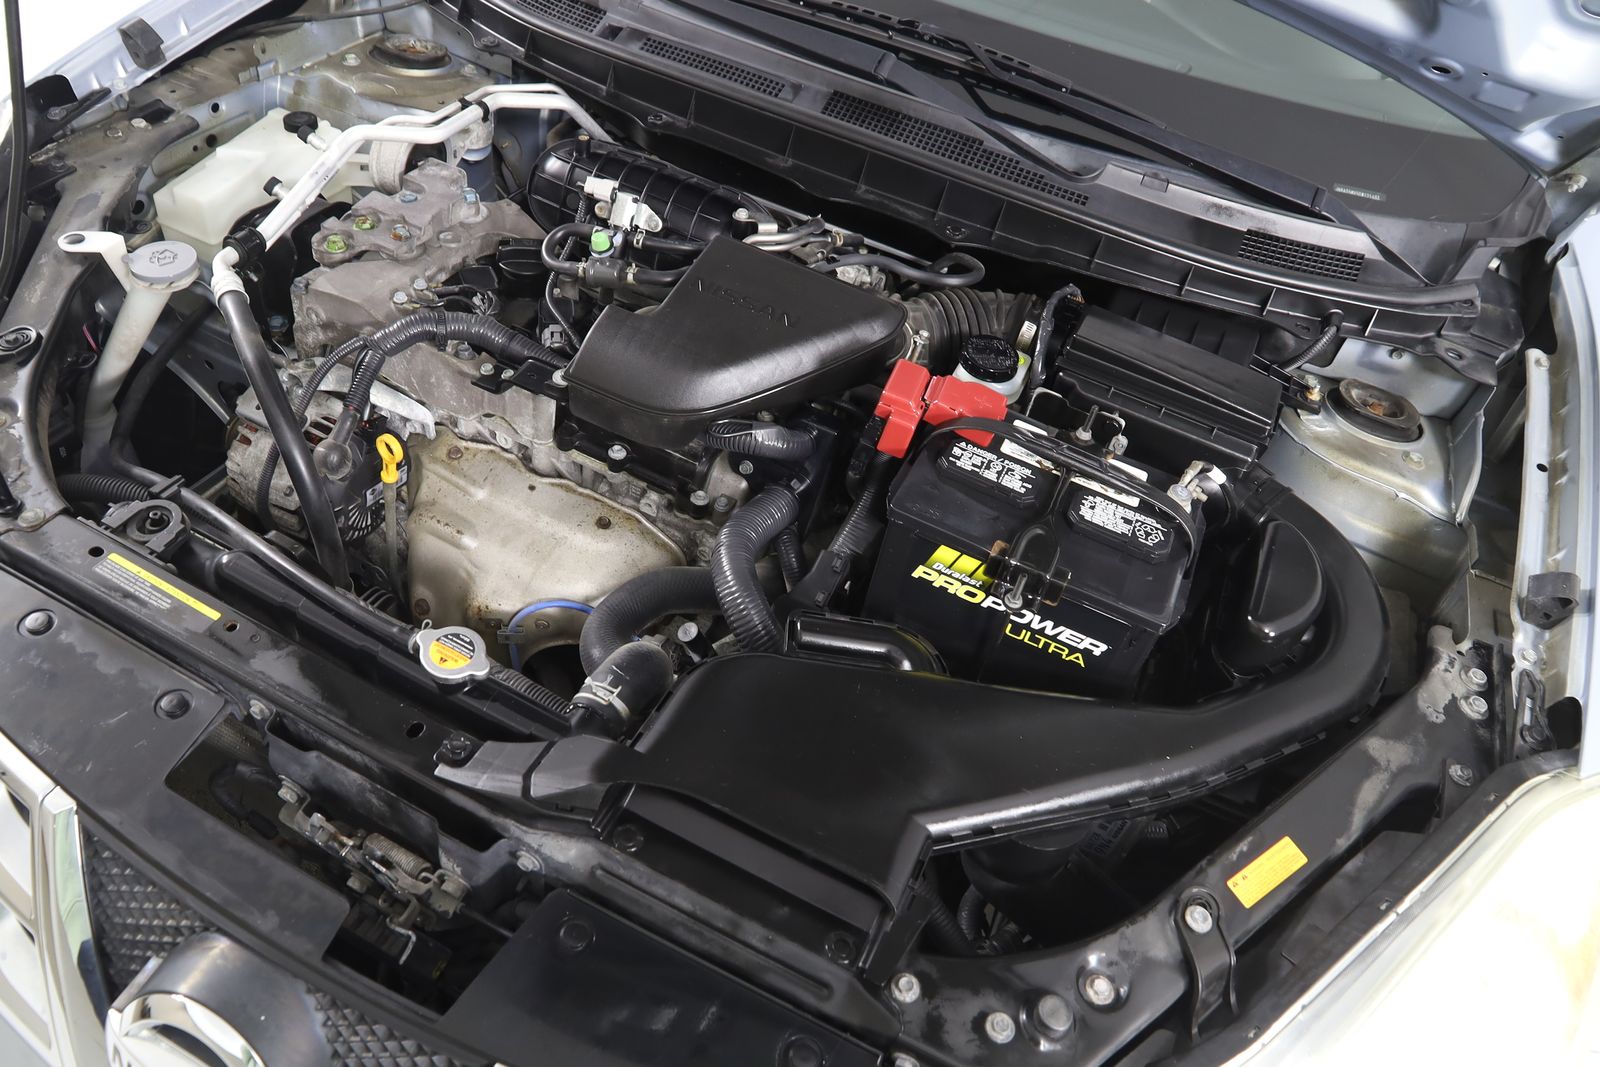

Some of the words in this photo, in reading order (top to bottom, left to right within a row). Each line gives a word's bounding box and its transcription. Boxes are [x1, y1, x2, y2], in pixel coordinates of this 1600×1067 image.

[967, 444, 998, 461] DANGER
[1004, 459, 1032, 475] POISON
[931, 561, 983, 589] Duralast
[1005, 623, 1086, 668] ULTRA
